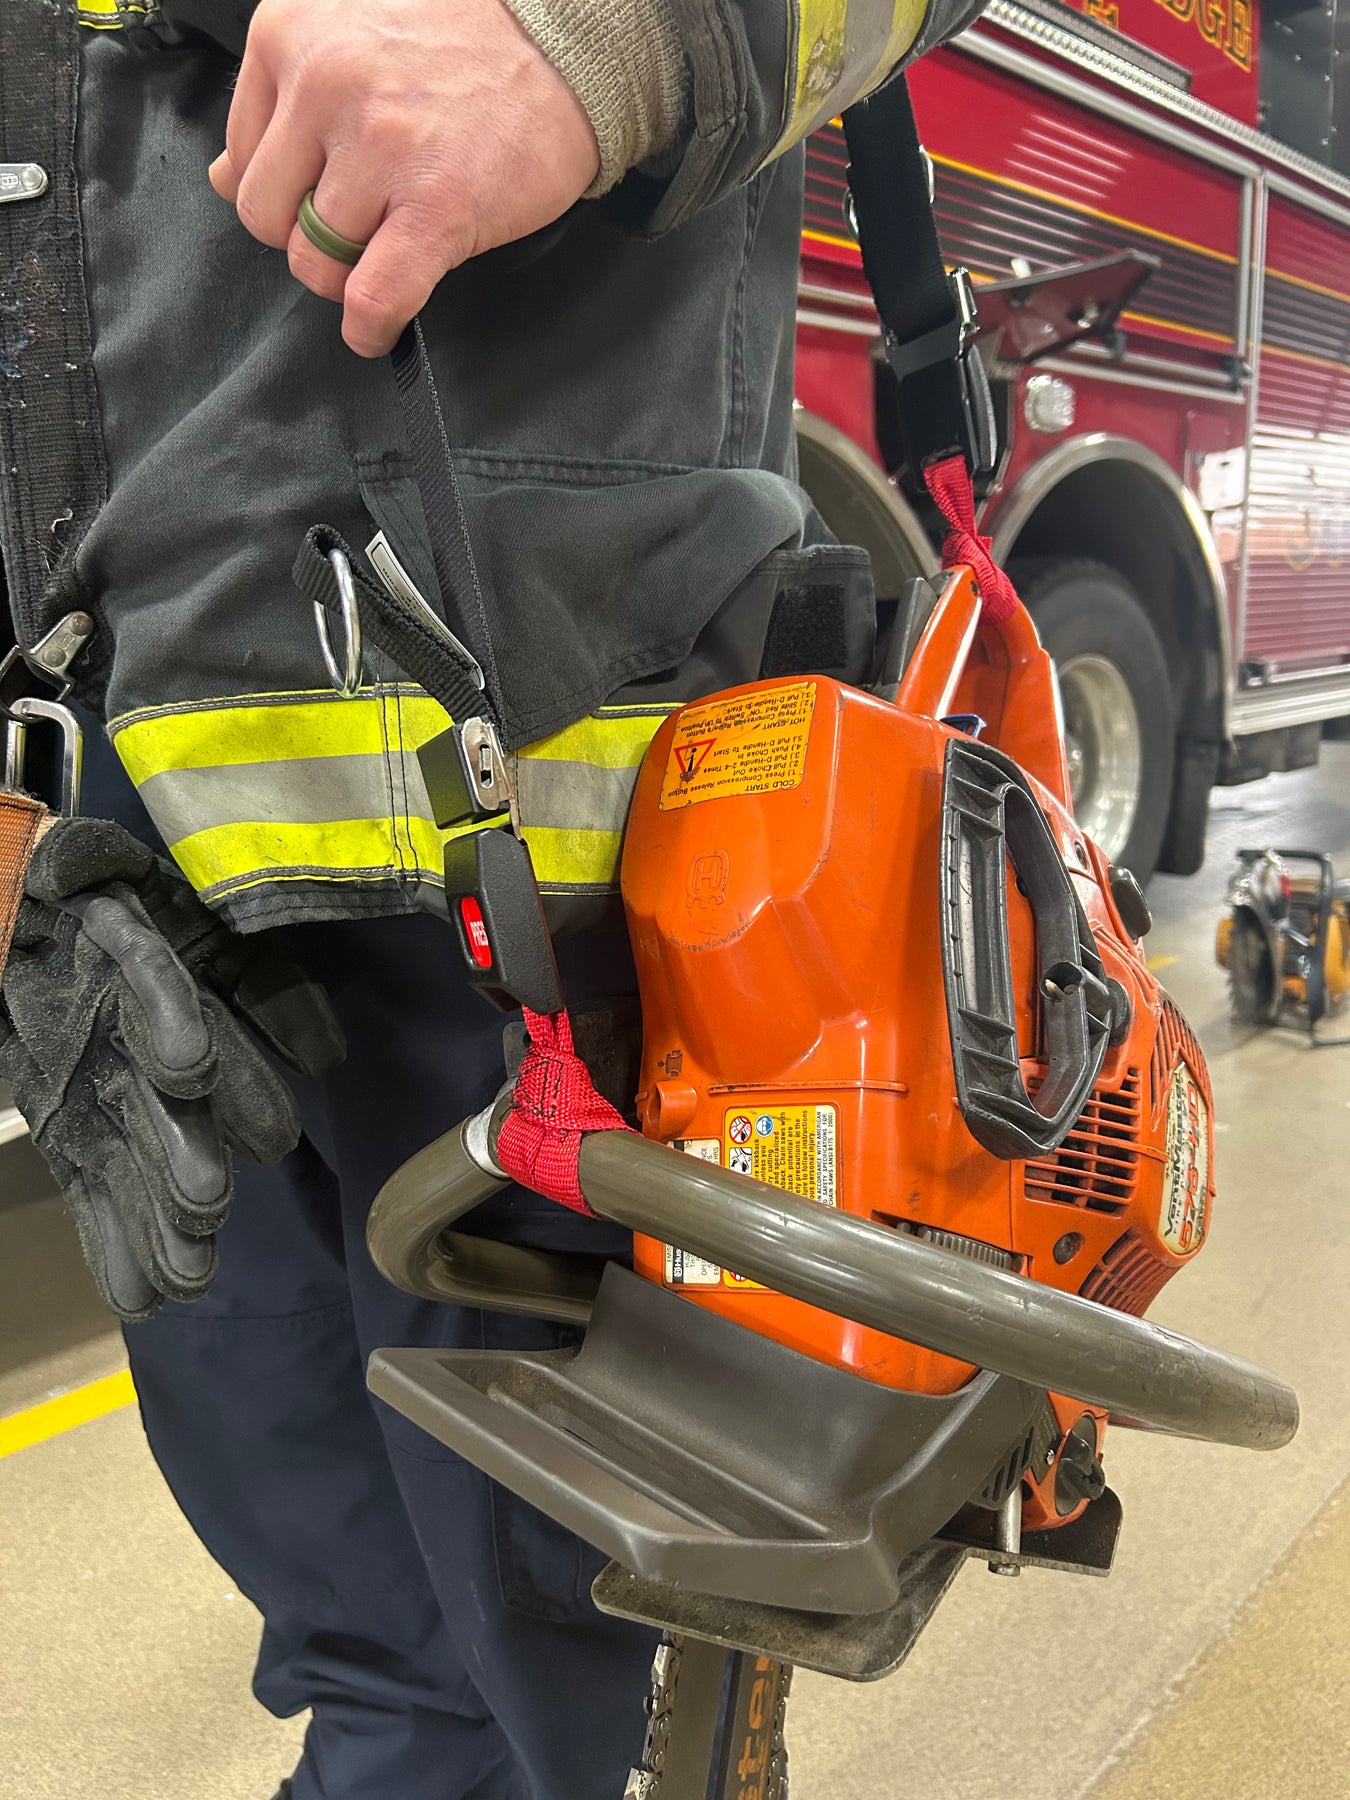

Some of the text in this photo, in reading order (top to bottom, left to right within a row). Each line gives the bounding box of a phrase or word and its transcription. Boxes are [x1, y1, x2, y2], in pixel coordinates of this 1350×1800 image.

[787, 693, 799, 701] Pull
[727, 705, 742, 714] Start
[766, 705, 778, 713] Red
[781, 701, 797, 710] Slide
[724, 712, 745, 721] Switch
[778, 710, 796, 718] Press
[763, 720, 786, 729] START
[687, 729, 705, 738] Button
[743, 740, 775, 751] D-Handle
[778, 737, 790, 745] Pull
[713, 749, 729, 757] Start
[747, 749, 768, 757] Choke
[772, 745, 788, 753] Push
[725, 762, 737, 770] 2-4
[740, 756, 772, 767] D-Handle
[704, 765, 722, 773] Times
[749, 765, 771, 773] Choke
[765, 770, 785, 778] Press
[717, 774, 762, 785] Compression
[690, 782, 714, 791] Release
[745, 779, 795, 791] COLD START
[668, 788, 688, 797] Button
[470, 920, 489, 946] PRES
